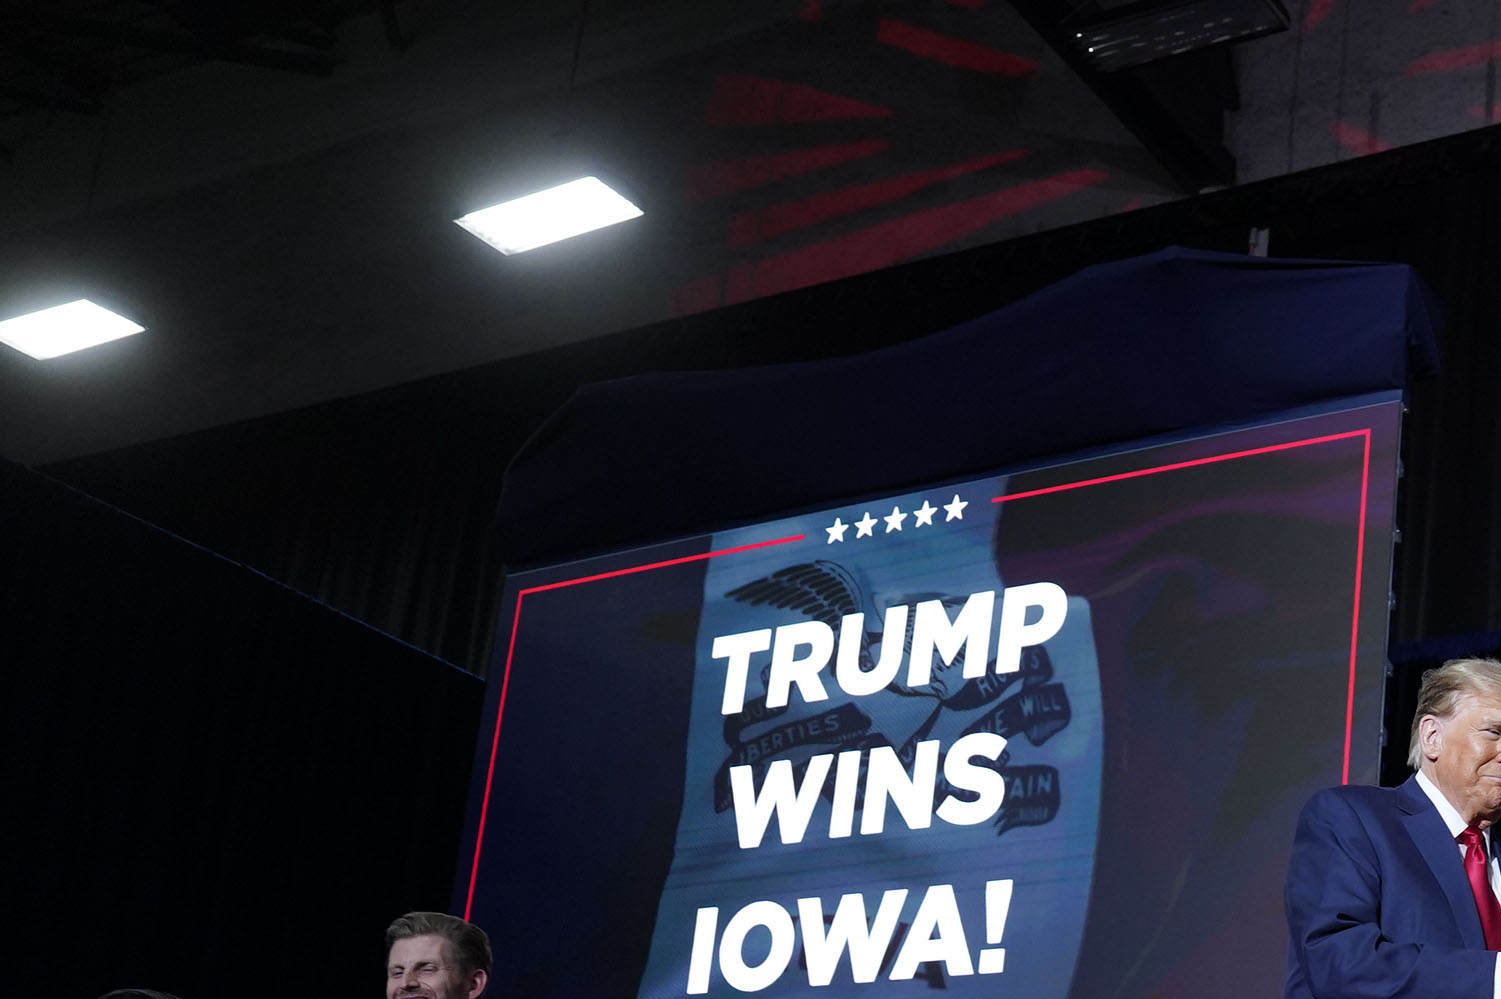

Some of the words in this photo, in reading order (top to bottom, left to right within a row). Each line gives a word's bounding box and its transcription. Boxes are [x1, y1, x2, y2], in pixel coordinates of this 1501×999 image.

[711, 582, 1068, 715] TRUMP
[1019, 695, 1062, 718] WILL
[729, 732, 1008, 849] WINS
[686, 879, 1014, 995] IOWA!
